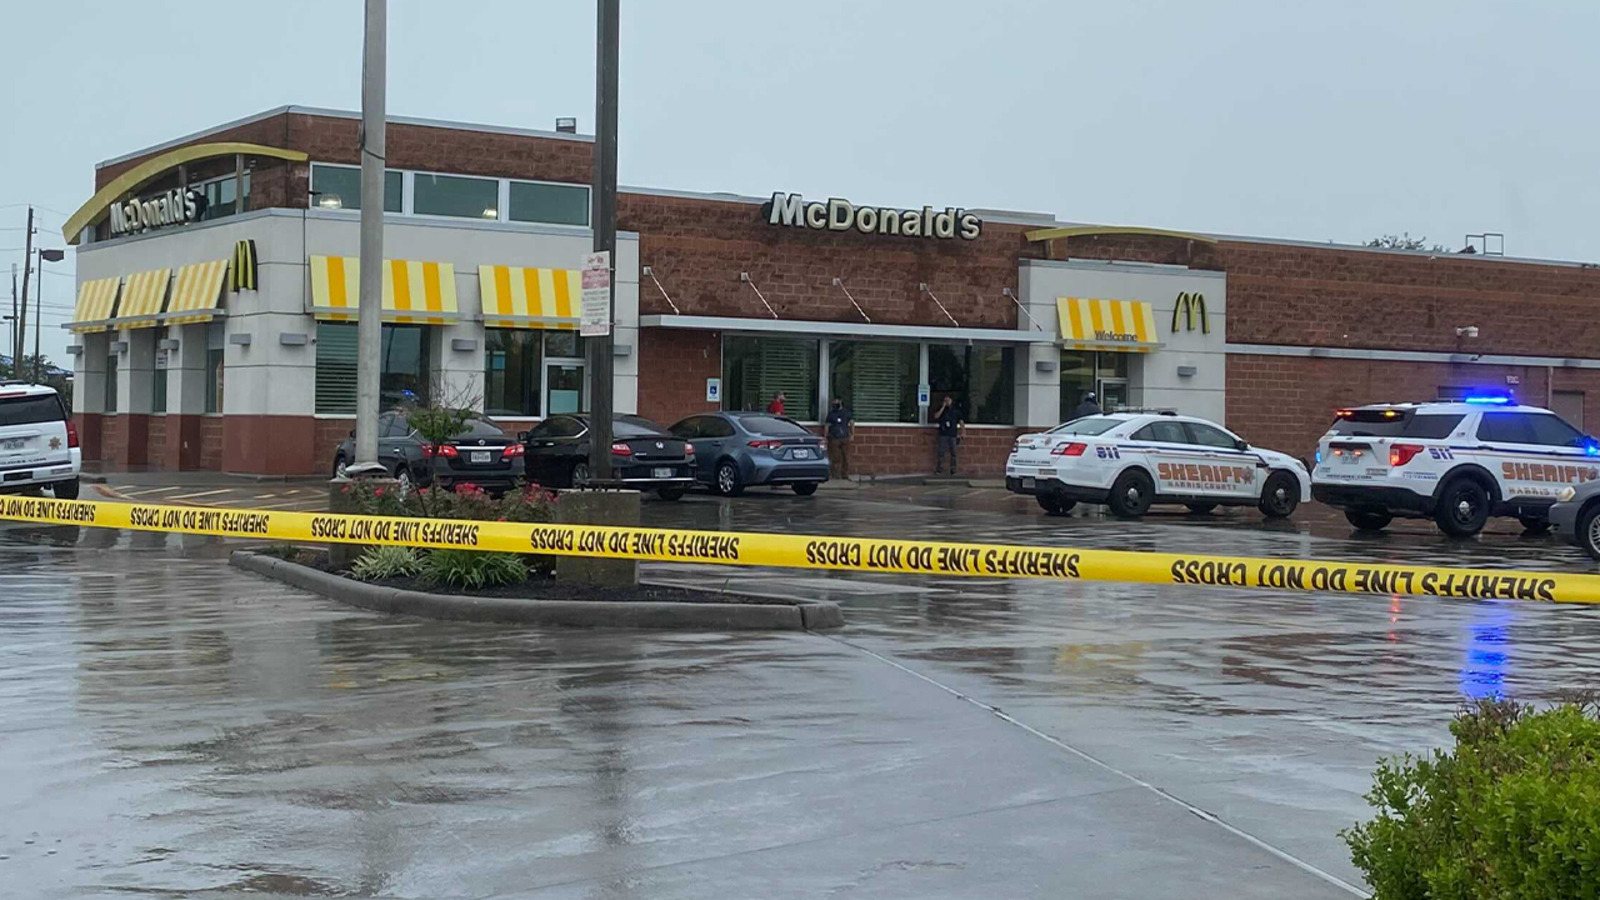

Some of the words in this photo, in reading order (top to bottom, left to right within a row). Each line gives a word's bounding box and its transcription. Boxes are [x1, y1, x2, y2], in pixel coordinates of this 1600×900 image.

[110, 186, 197, 234] McDonald's
[769, 192, 981, 240] McDonald's
[1094, 330, 1139, 342] Welcome
[1096, 446, 1121, 460] 911
[1157, 462, 1244, 483] SHERIFF
[1501, 461, 1589, 484] SHERIFF
[1167, 481, 1200, 489] HARRIS
[6, 500, 22, 517] NOT
[23, 501, 36, 518] DO
[36, 501, 55, 520] LINE
[130, 507, 160, 527] CROSS
[162, 509, 181, 529] NOT
[183, 510, 196, 530] DO
[199, 511, 220, 531] LINE
[222, 512, 270, 534] SHERIFFS
[311, 517, 347, 539] CROSS
[348, 518, 373, 540] NOT
[374, 519, 391, 541] DO
[393, 520, 420, 542] LINE
[421, 521, 479, 546] SHERIFFS
[530, 528, 575, 551] CROSS
[577, 530, 607, 553] NOT
[608, 531, 630, 554] DO
[632, 532, 666, 556] LINE
[668, 533, 740, 560] SHERIFFS
[806, 541, 862, 567] CROSS
[866, 544, 904, 569] NOT
[906, 546, 933, 571] DO
[937, 547, 981, 573] LINE
[984, 549, 1080, 578] SHERIFFS
[1171, 560, 1248, 586] CROSS
[1255, 564, 1305, 590] NOT
[1311, 567, 1347, 592] DO
[1354, 570, 1415, 596] LINE
[1421, 573, 1556, 602] SHERIFFS
